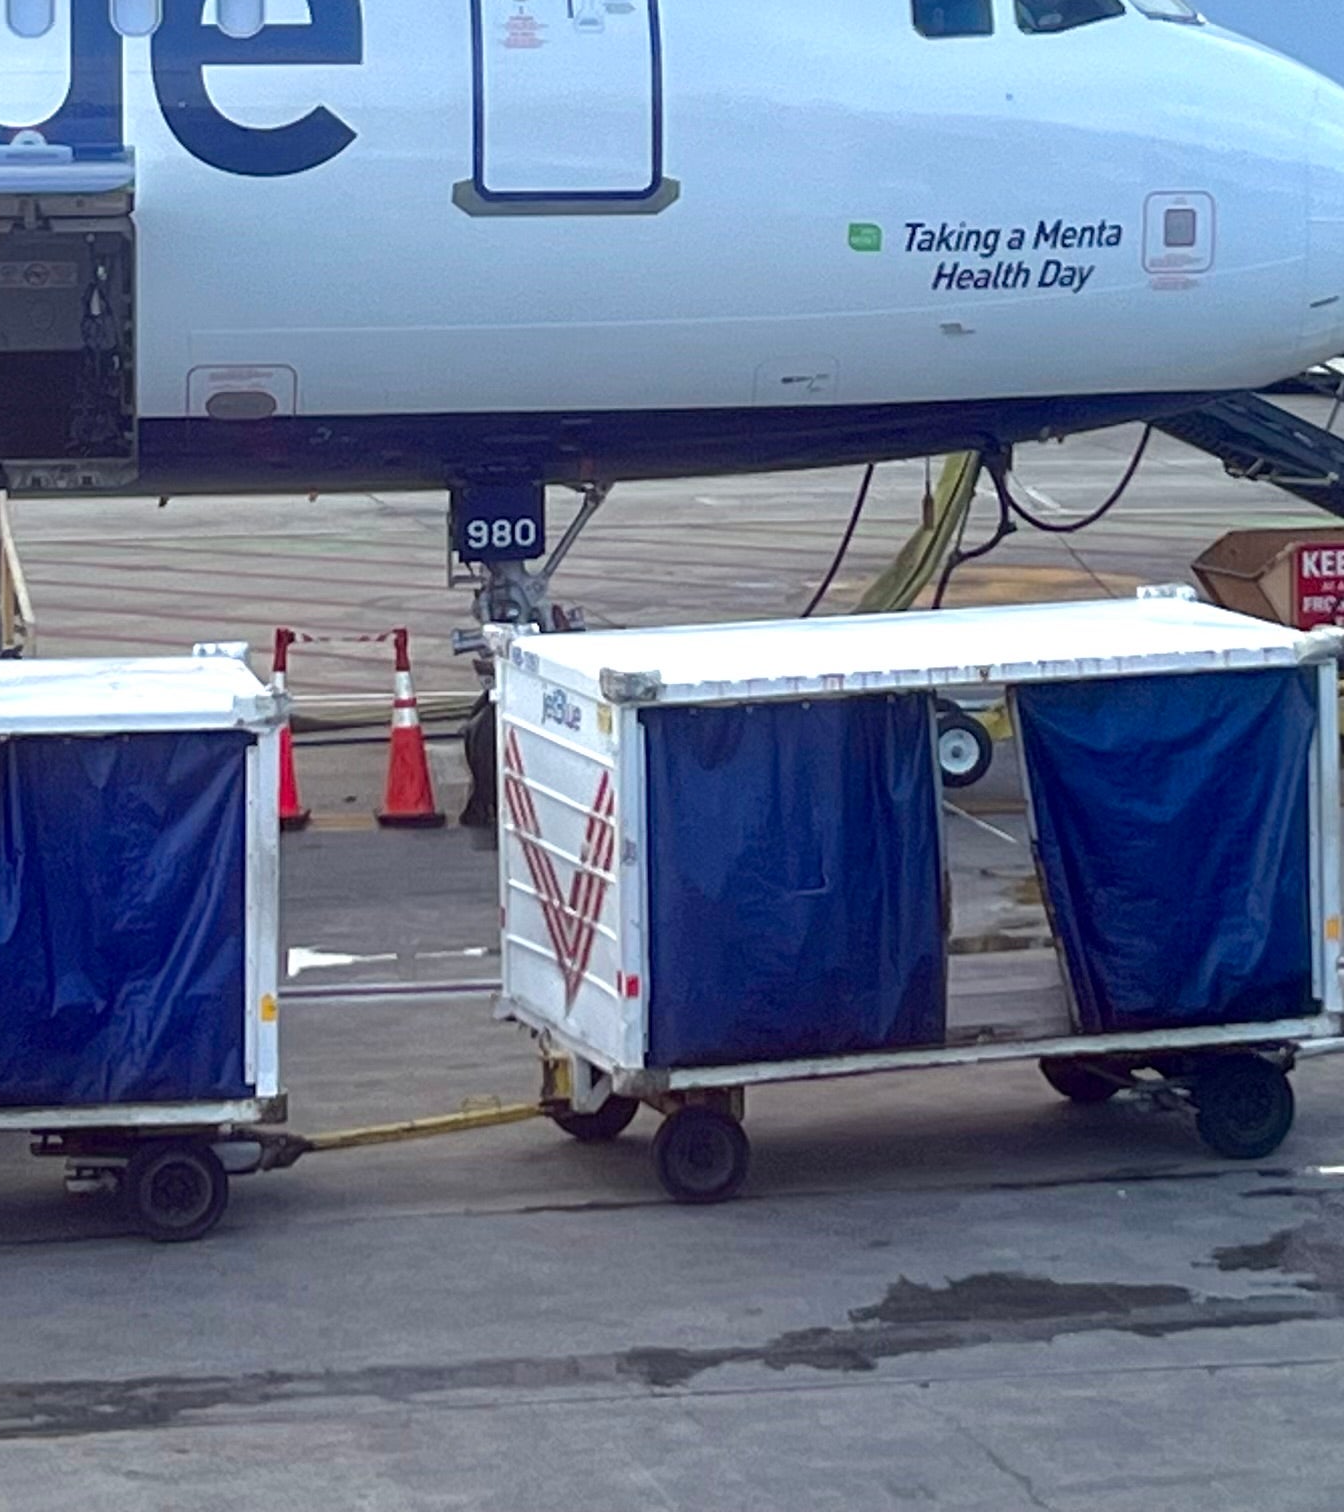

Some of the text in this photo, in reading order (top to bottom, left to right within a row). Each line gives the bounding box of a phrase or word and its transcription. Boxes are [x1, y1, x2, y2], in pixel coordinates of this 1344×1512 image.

[903, 219, 1122, 257] Taking a Menta
[931, 259, 1095, 293] Health Day
[467, 517, 537, 548] 980
[541, 683, 582, 732] jetBlue
